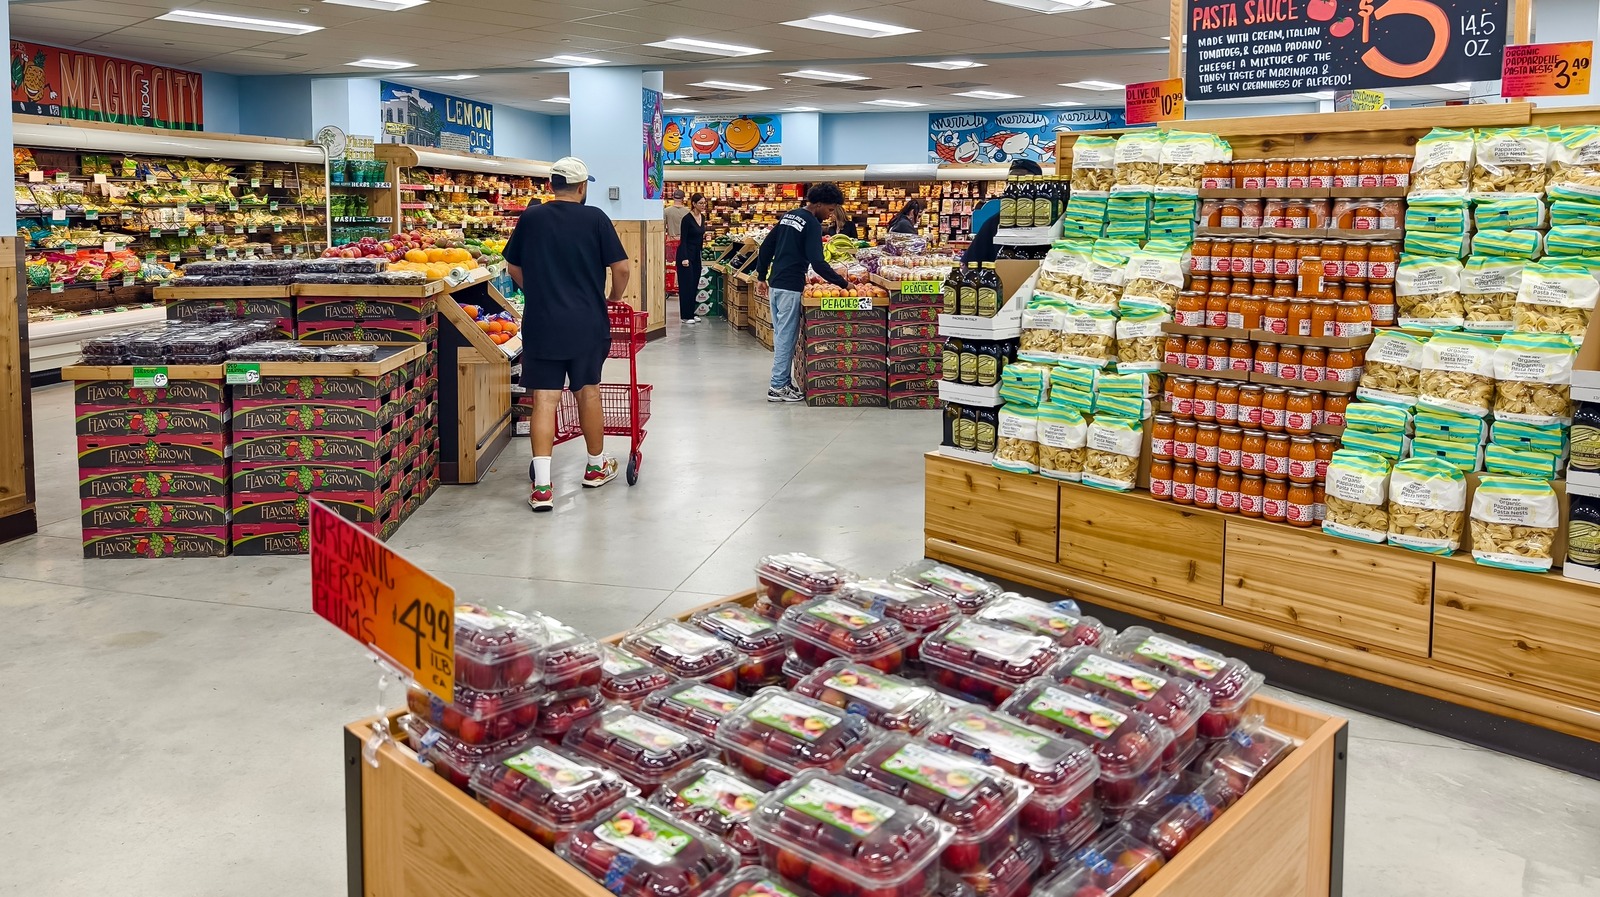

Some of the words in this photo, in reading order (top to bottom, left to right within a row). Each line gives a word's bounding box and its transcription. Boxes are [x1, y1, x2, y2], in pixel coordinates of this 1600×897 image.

[1193, 3, 1238, 31] PASTA
[1244, 0, 1298, 25] SAUCE
[1460, 12, 1496, 36] 14.5
[1198, 36, 1223, 47] MADE
[1226, 33, 1249, 44] WITH
[1252, 30, 1285, 42] CREAM,
[1286, 26, 1320, 38] ITALIAN
[1199, 48, 1242, 60] TOMATOES,
[1243, 46, 1249, 55] &
[1252, 43, 1282, 55] GRANA
[1285, 40, 1322, 52] PADANO
[1464, 39, 1492, 57] OZ
[1506, 48, 1540, 57] ORGANIC
[1199, 60, 1236, 72] CHEESE!
[1240, 58, 1246, 67] A
[1250, 55, 1293, 68] MIXTURE
[1297, 53, 1309, 63] OF
[1314, 52, 1332, 62] THE
[1506, 55, 1560, 67] PAPPARDELLE
[1199, 72, 1226, 84] TANGY
[1229, 69, 1254, 80] TASTE
[1257, 68, 1266, 78] OF
[1269, 66, 1318, 78] MARINARA
[1322, 64, 1329, 75] &
[1504, 66, 1528, 75] PASTA
[1529, 65, 1553, 74] NESTS
[60, 52, 145, 127] MAGIC
[151, 67, 203, 131] CITY
[1199, 84, 1213, 94] THE
[1217, 82, 1240, 93] SILKY
[1242, 79, 1290, 91] CREAMINESS
[1292, 78, 1304, 88] OF
[1307, 74, 1352, 87] ALFREDO!
[1126, 88, 1150, 100] OLIVE
[1151, 87, 1160, 98] OIL
[1161, 93, 1183, 116] 10.99
[445, 97, 491, 131] LEMON
[932, 112, 986, 142] merrily
[996, 112, 1048, 133] merrily
[1058, 110, 1116, 128] merrily
[469, 130, 491, 149] CITY
[904, 284, 934, 293] PEACHES
[248, 303, 280, 315] GROWN
[325, 305, 354, 318] FLAVOR
[364, 304, 396, 316] GROWN
[822, 299, 858, 309] PEACHES
[323, 332, 352, 341] FLAVOR
[362, 332, 392, 341] GROWN
[87, 385, 124, 400] FLAVOR
[170, 385, 208, 399] GROWN
[246, 382, 280, 396] FLAVOR
[326, 381, 364, 395] GROWN
[88, 416, 124, 432] FLAVOR
[170, 416, 209, 430] GROWN
[246, 412, 281, 428] FLAVOR
[326, 412, 364, 427] GROWN
[110, 449, 145, 464] FLAVOR
[156, 448, 193, 462] GROWN
[246, 444, 281, 459] FLAVOR
[326, 443, 364, 456] GROWN
[92, 480, 128, 496] FLAVOR
[173, 480, 212, 493] GROWN
[246, 474, 280, 489] FLAVOR
[326, 474, 363, 487] GROWN
[94, 510, 130, 526] FLAVOR
[174, 509, 212, 522] GROWN
[261, 506, 294, 519] FLAVOR
[96, 541, 132, 556] FLAVOR
[176, 540, 214, 552] GROWN
[264, 537, 297, 551] FLAVOR
[312, 507, 395, 590] ORGANIC
[311, 546, 380, 615] CHERRY
[314, 583, 376, 646] PLUMS
[432, 676, 447, 689] EA
